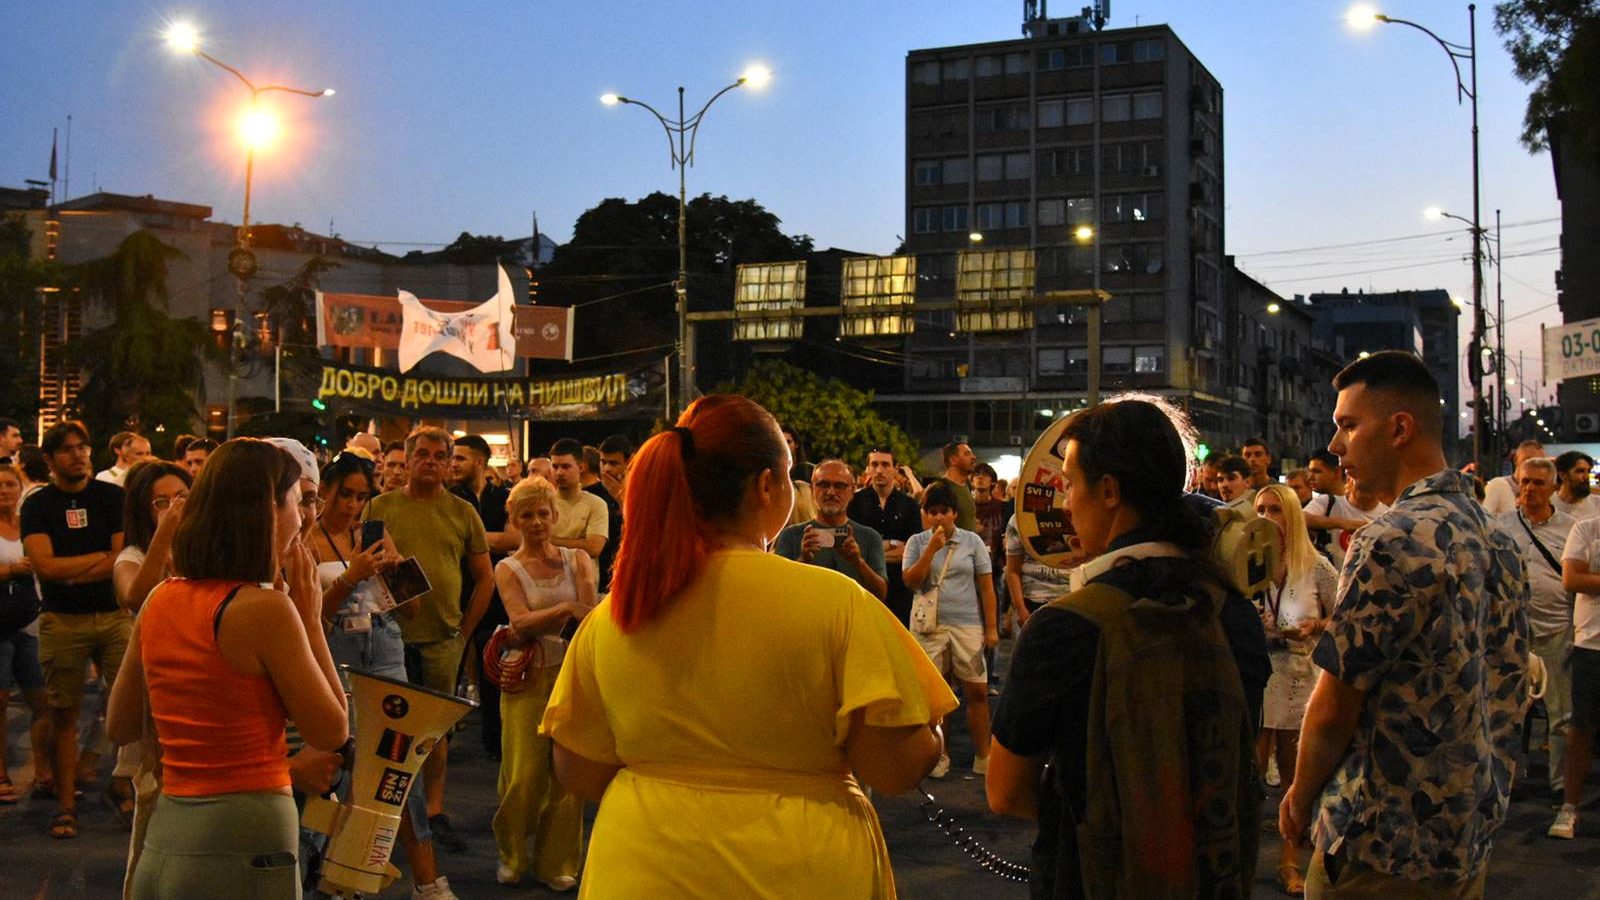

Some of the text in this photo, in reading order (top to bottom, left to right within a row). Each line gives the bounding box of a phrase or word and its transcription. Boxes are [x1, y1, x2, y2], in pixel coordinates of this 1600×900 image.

[318, 366, 628, 408] ДОБРО ДОШЛИ НА НИШВИЛ
